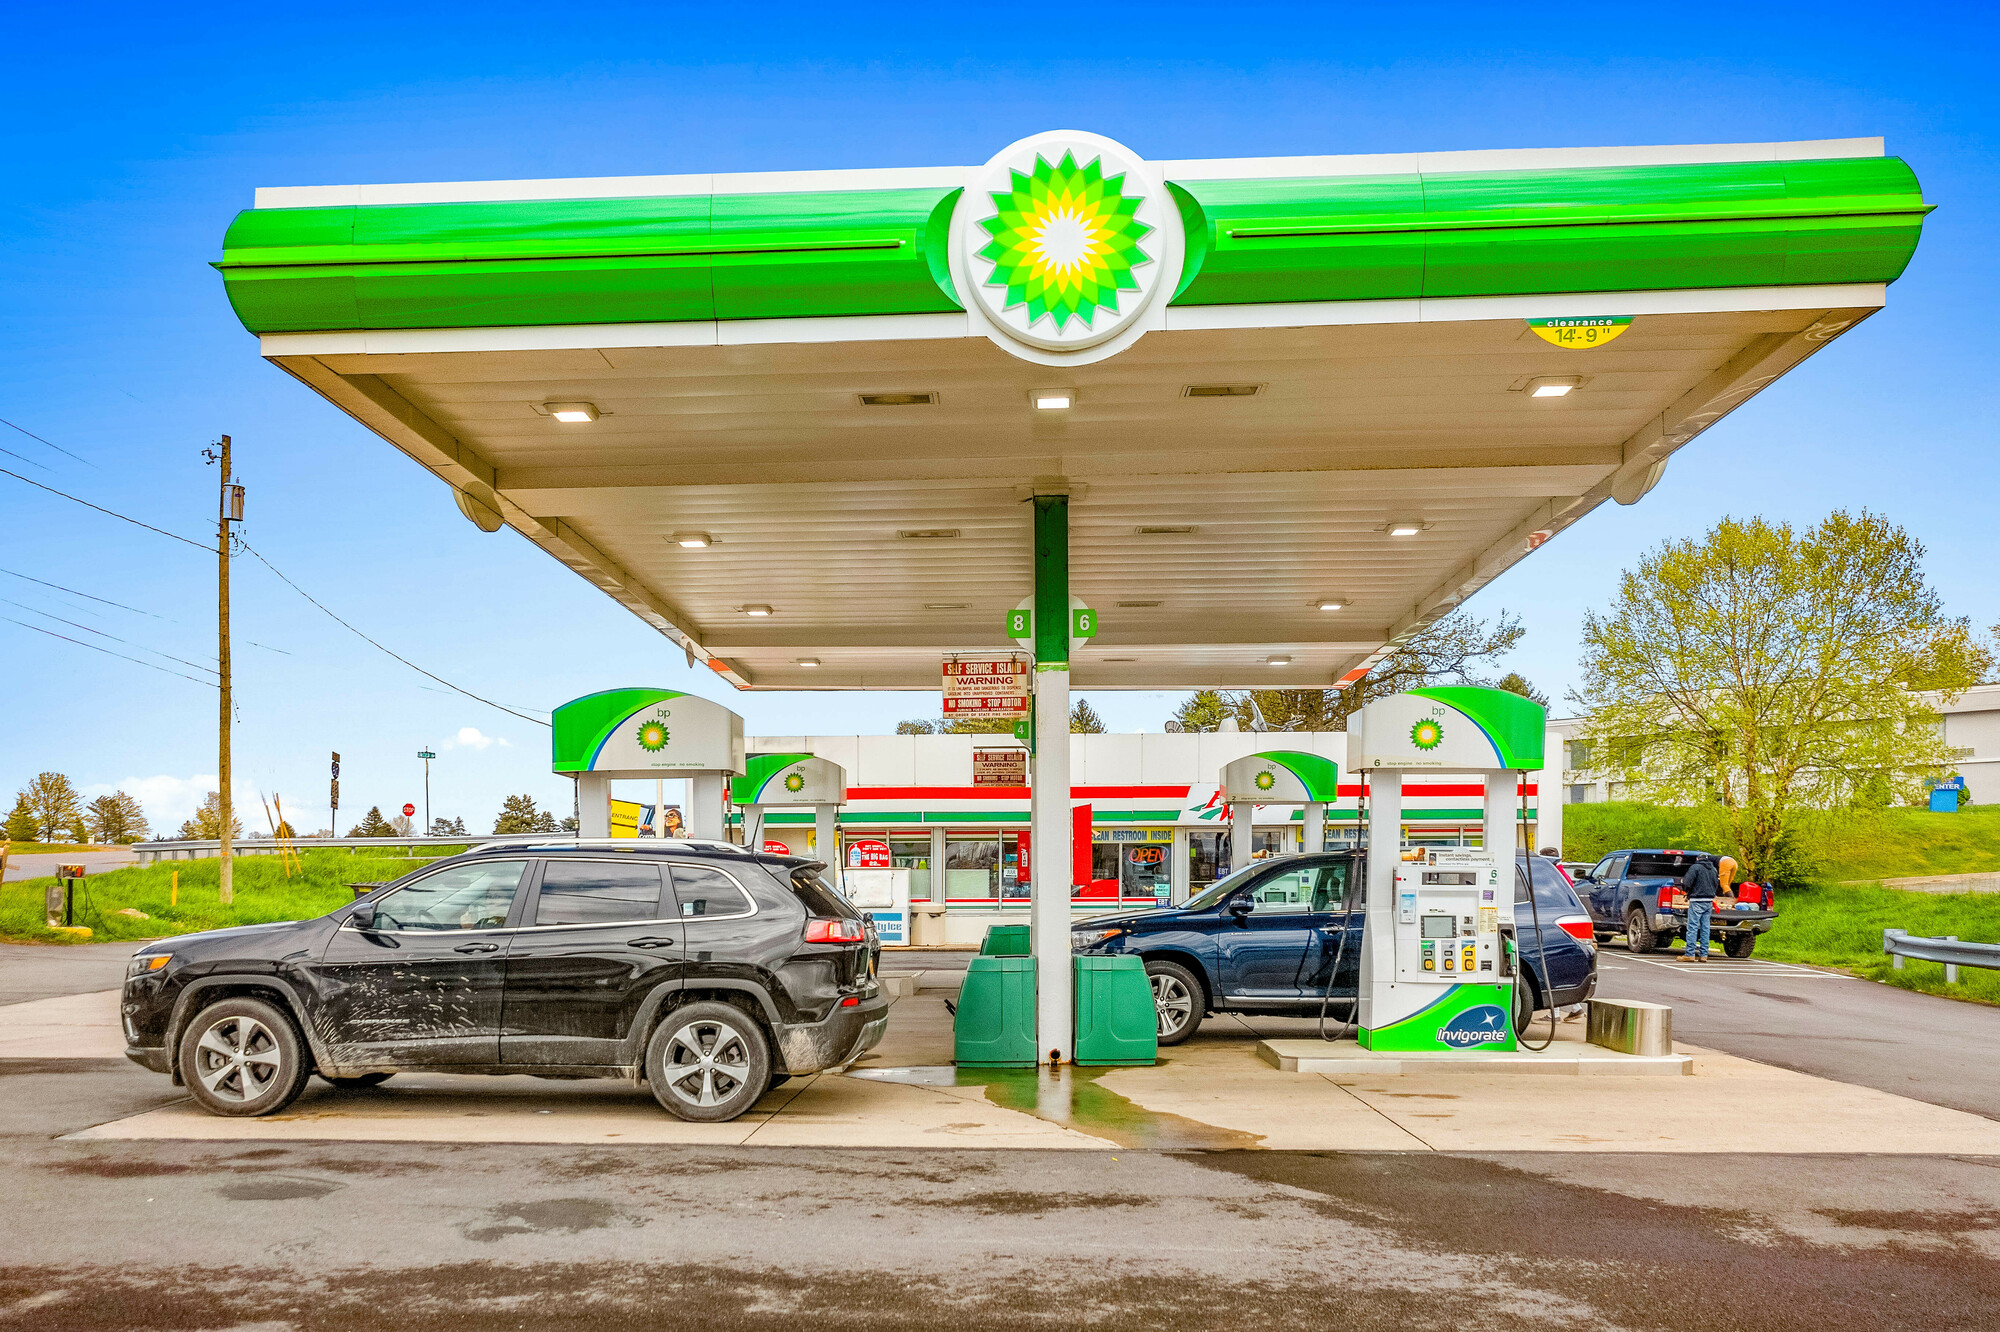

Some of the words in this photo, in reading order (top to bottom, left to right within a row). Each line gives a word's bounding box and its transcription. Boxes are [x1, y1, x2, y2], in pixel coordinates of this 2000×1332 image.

[1547, 319, 1613, 327] clearance
[1013, 614, 1024, 631] 8
[1080, 614, 1090, 630] 6
[948, 663, 962, 674] SELF
[966, 663, 992, 674] SERVICE
[996, 662, 1022, 674] ISLAND
[956, 676, 1014, 684] WARNING
[948, 699, 956, 708] NO
[958, 699, 982, 708] SMOKING
[988, 698, 1001, 707] STOP
[1002, 698, 1022, 706] MOTOR
[658, 708, 670, 719] bp
[1432, 706, 1445, 717] bp
[1018, 725, 1024, 734] 4
[612, 813, 638, 821] ENTRANC
[1092, 831, 1109, 840] LEAN
[1113, 831, 1147, 840] RESTROOM
[1151, 831, 1171, 840] INSIDE
[1129, 848, 1165, 862] OPEN
[1491, 870, 1497, 878] 6
[1437, 1028, 1506, 1043] Invigorate
